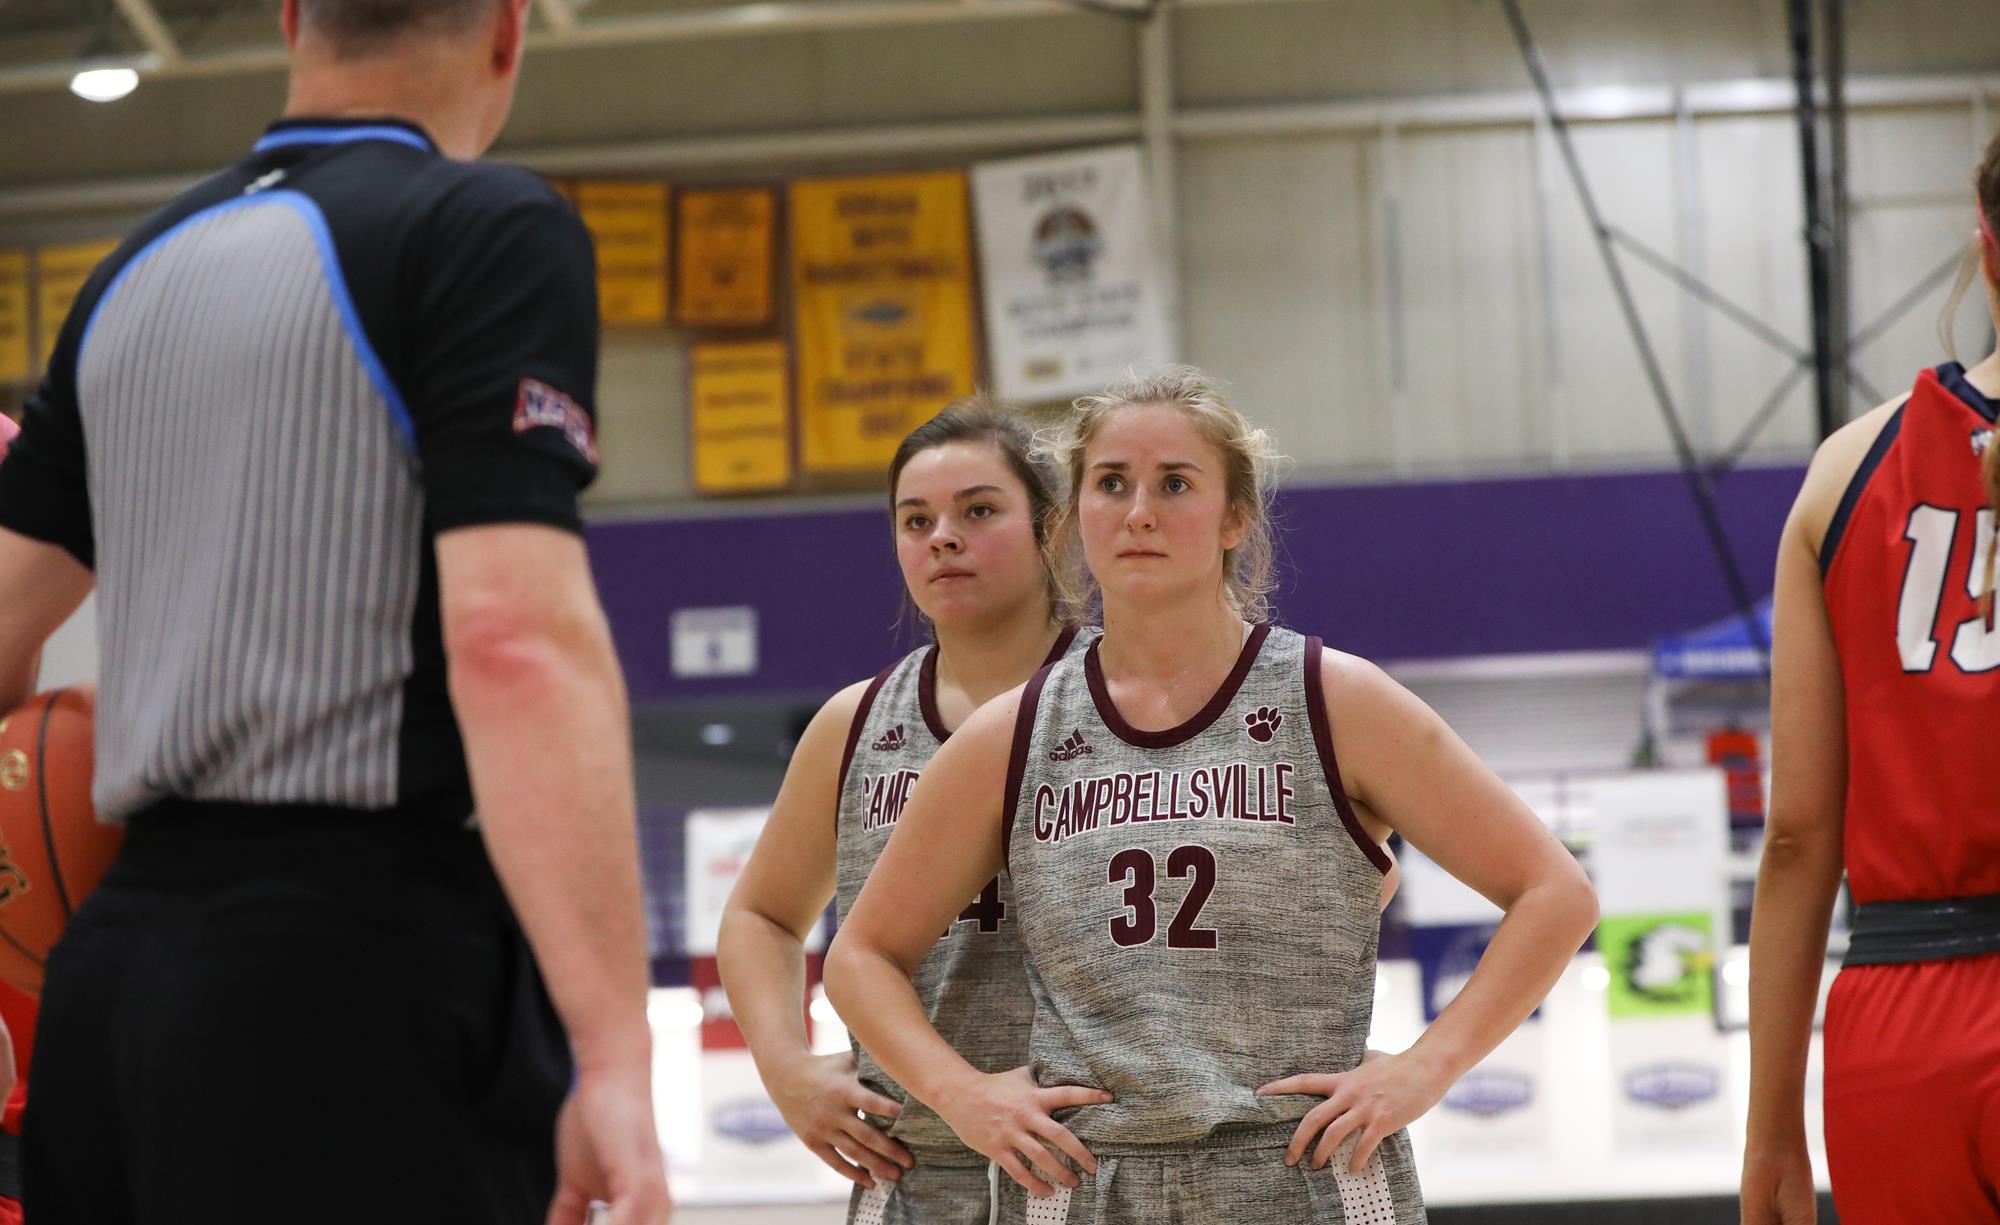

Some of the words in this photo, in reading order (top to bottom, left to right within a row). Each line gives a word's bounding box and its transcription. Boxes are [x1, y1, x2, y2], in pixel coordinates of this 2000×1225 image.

[1049, 744, 1093, 762] adidas
[1034, 763, 1295, 843] CAMPBELLSVILLE
[1108, 844, 1219, 950] 32
